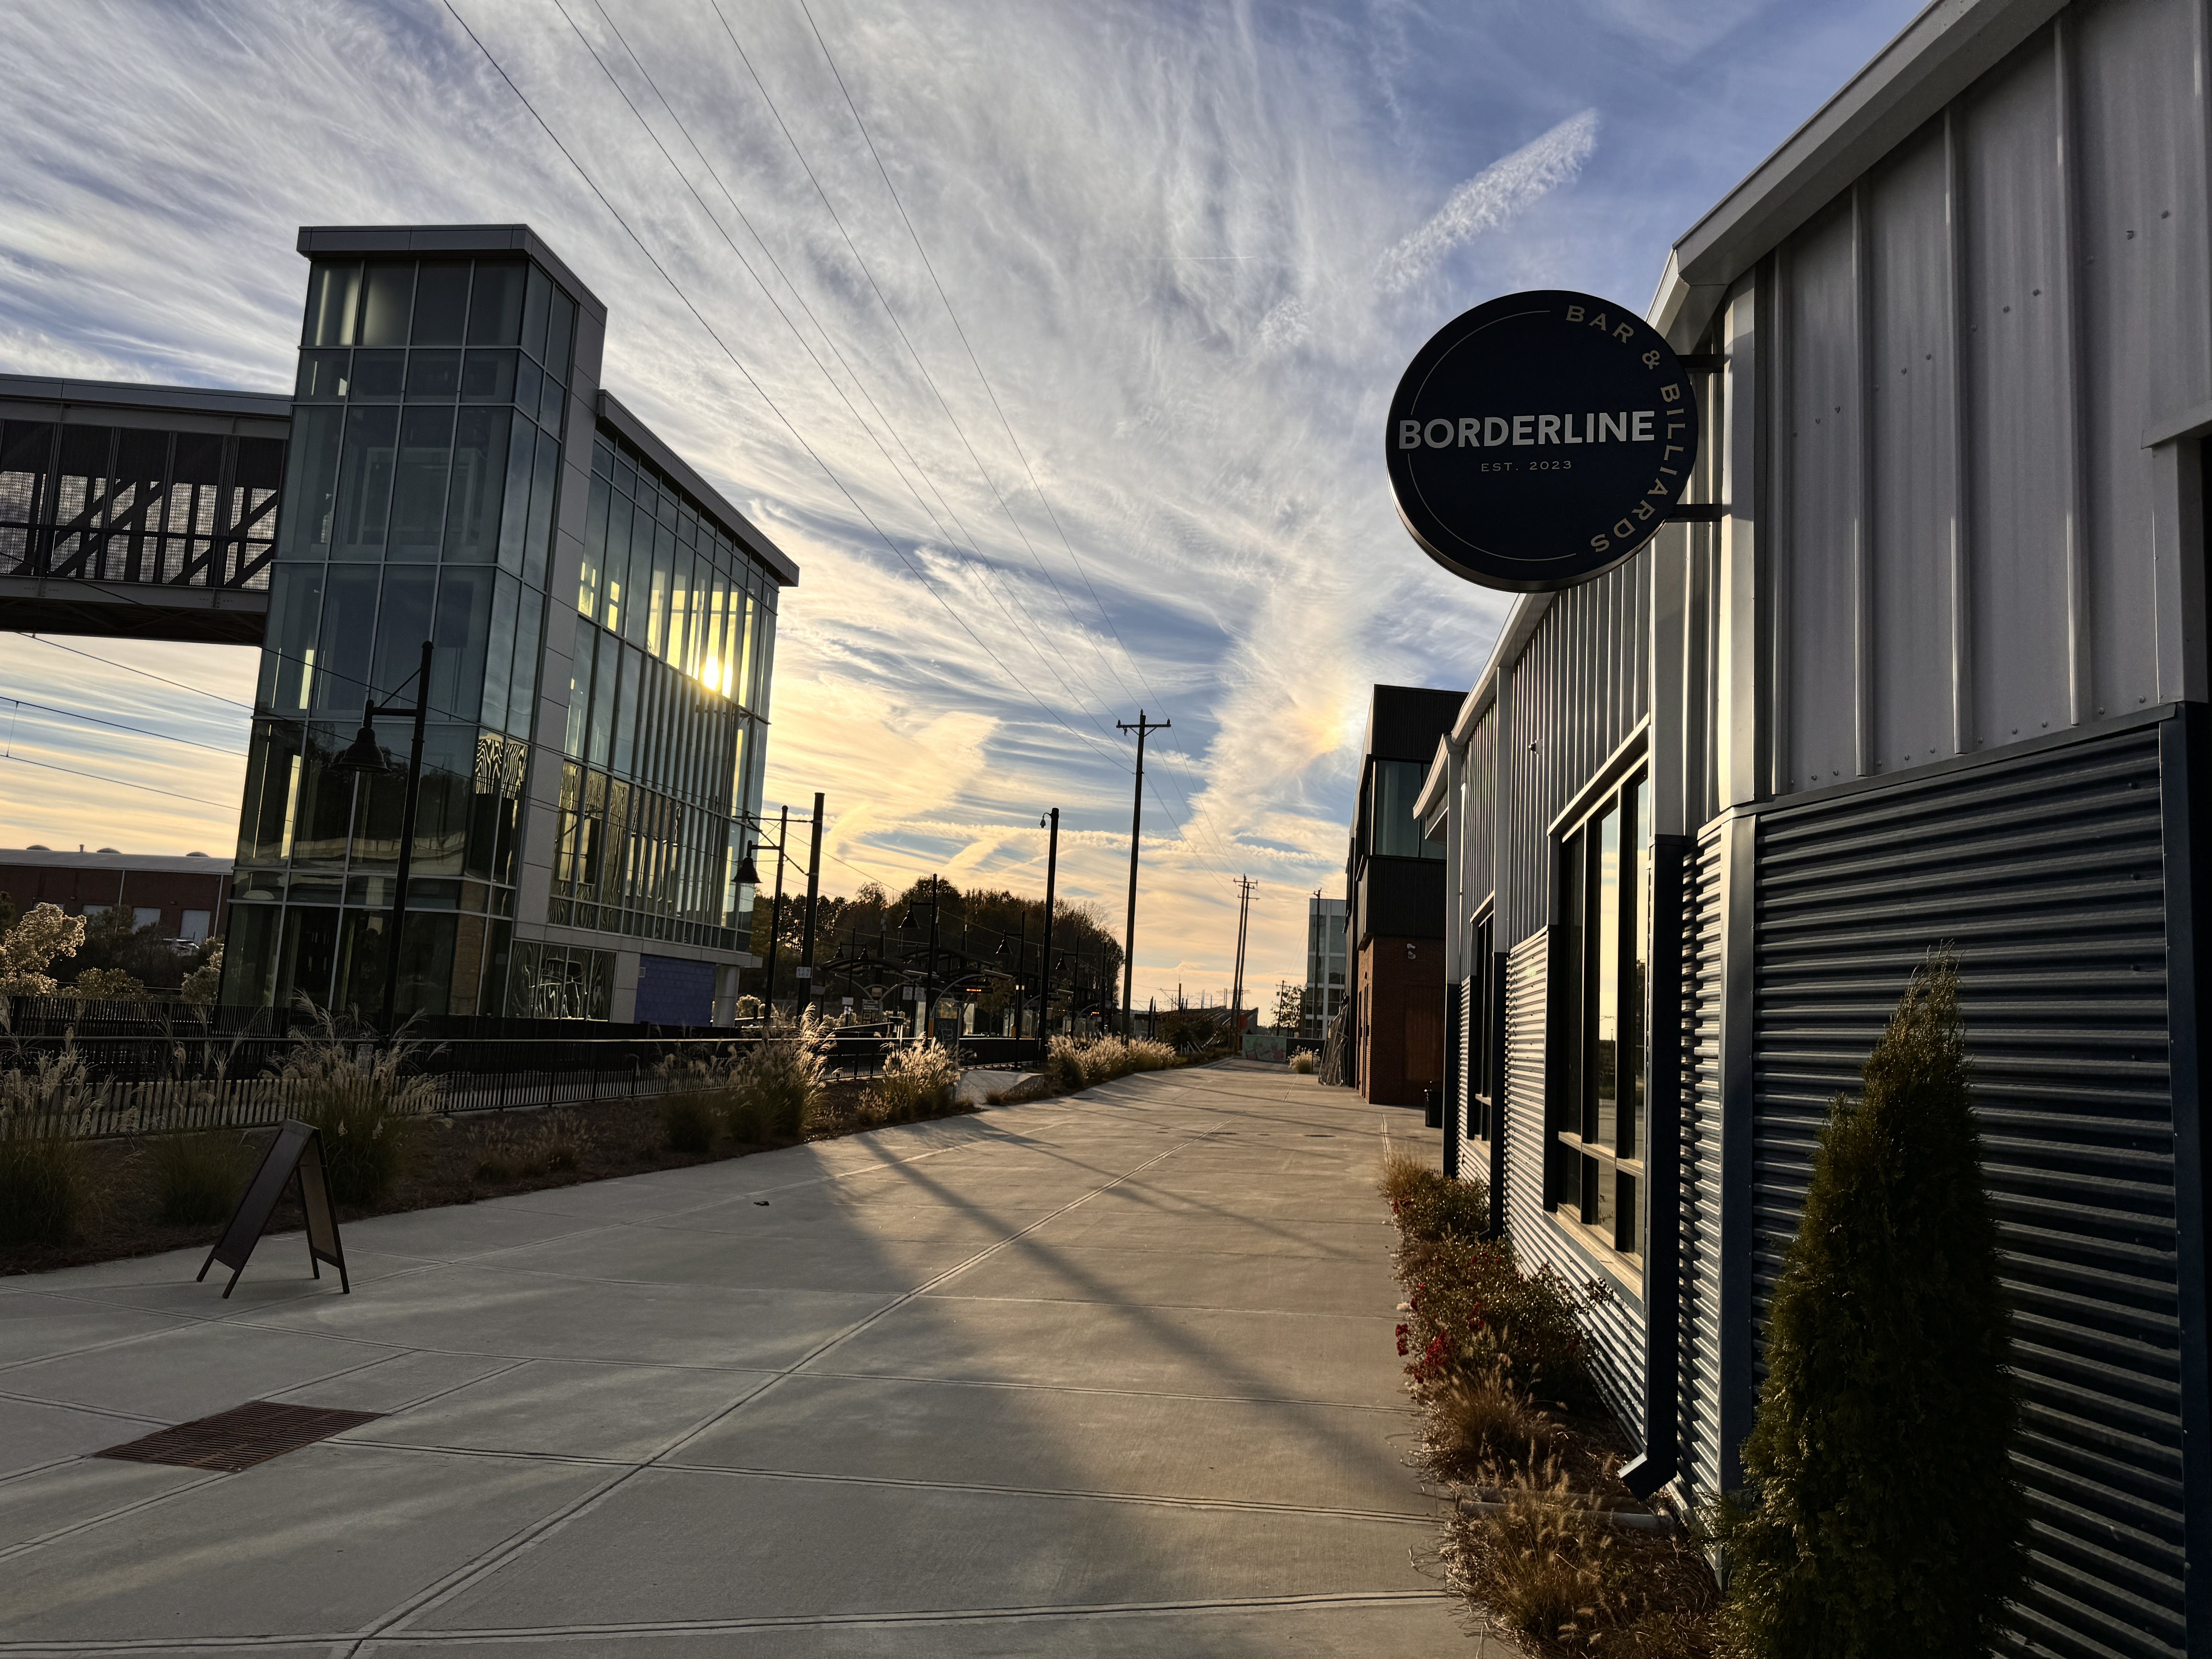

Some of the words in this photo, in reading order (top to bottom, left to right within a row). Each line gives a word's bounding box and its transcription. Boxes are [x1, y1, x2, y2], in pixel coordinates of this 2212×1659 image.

[1565, 305, 1633, 343] BAR
[1642, 350, 1662, 370] &
[1399, 411, 1655, 449] BORDERLINE
[1482, 463, 1519, 472] EST.
[1529, 460, 1572, 471] 2023
[1590, 383, 1685, 553] BILLIARDS
